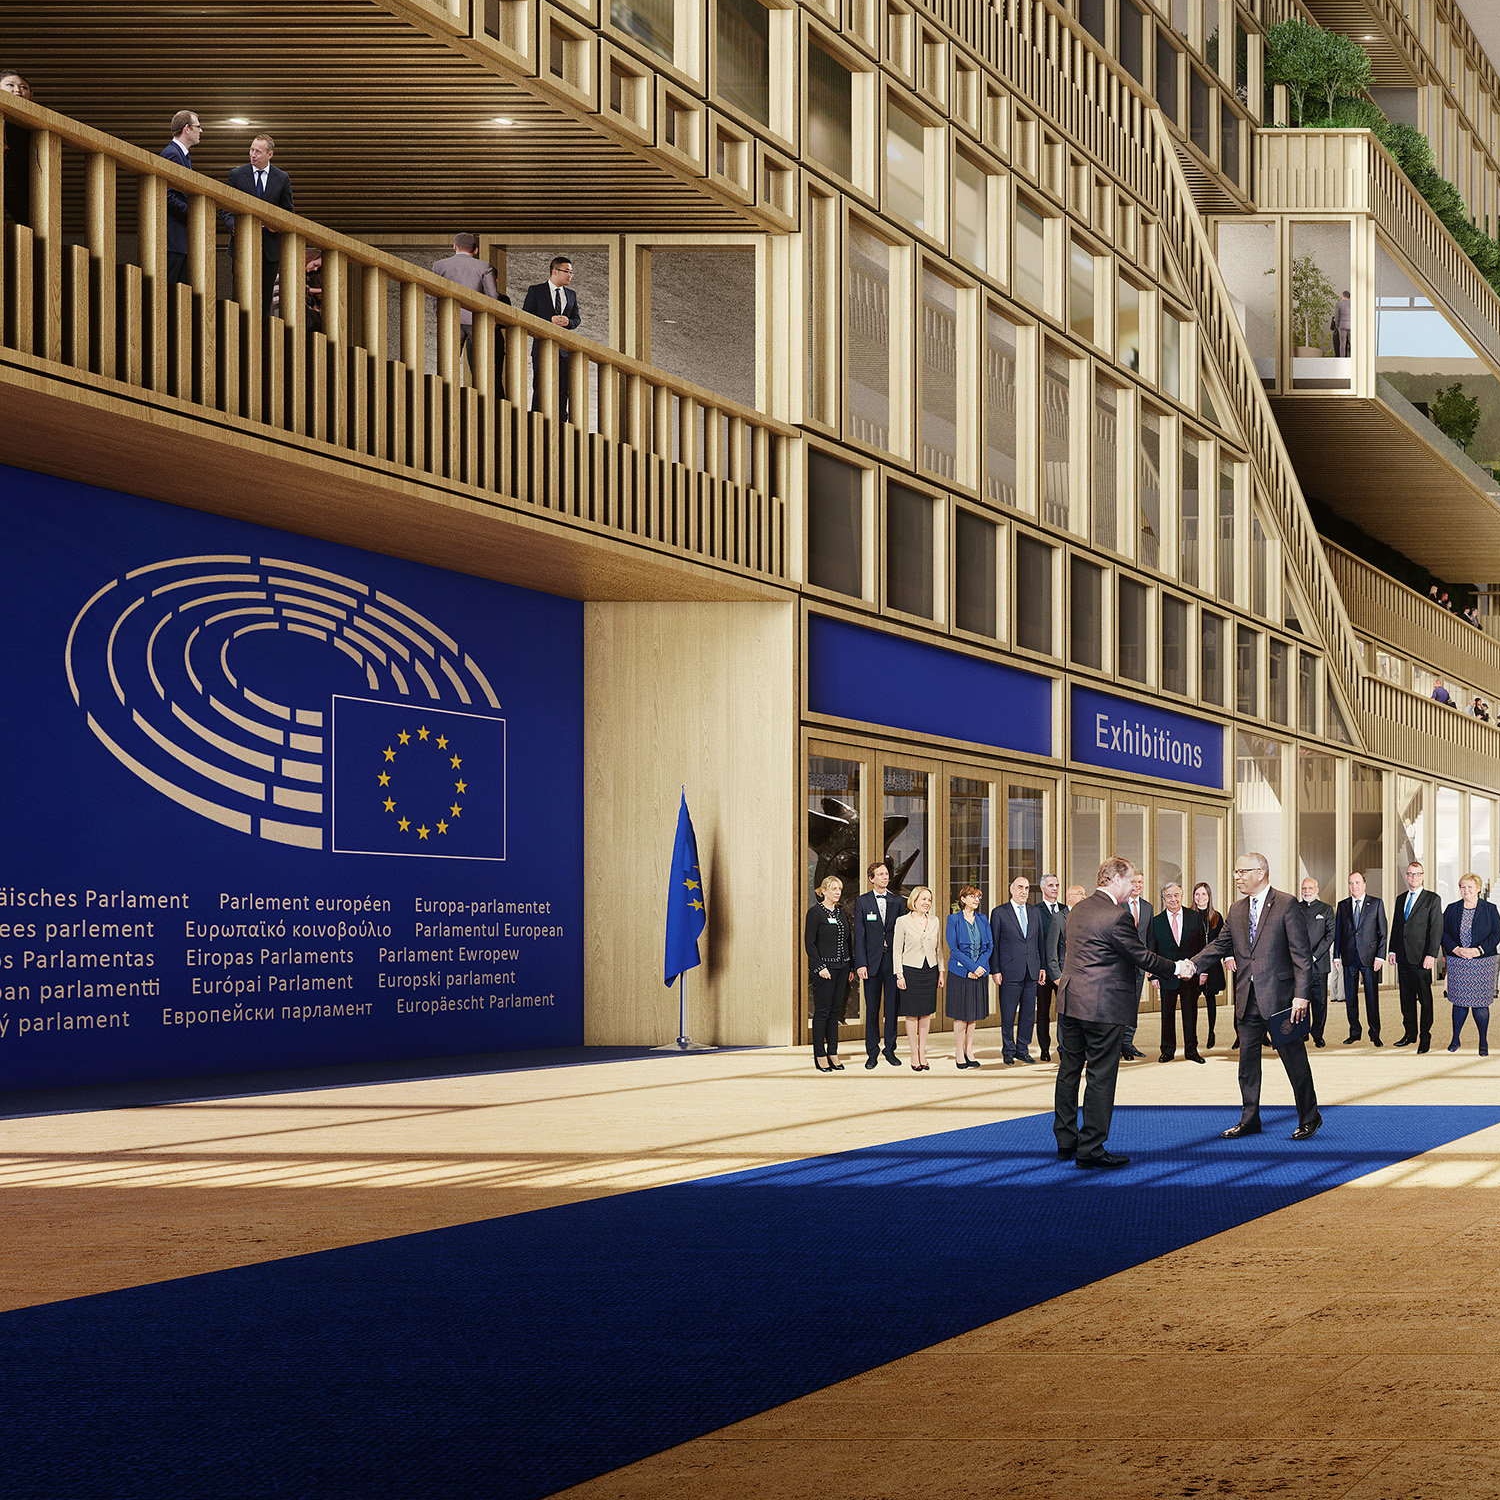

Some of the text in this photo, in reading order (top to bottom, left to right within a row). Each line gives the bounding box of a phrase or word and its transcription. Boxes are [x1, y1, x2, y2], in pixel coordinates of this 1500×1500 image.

[1096, 712, 1203, 769] Exhibitions
[86, 889, 190, 909] Parlament
[220, 892, 391, 916] Parlement européen
[415, 897, 551, 917] Europa-parlamentet
[0, 919, 155, 943] ees parlement
[186, 918, 392, 942] Ευρωπαϊκό κοινοβούλιο
[415, 921, 564, 941] Parlamentul European
[23, 949, 155, 969] Parlamentas
[186, 947, 354, 970] Eiropas Parlaments
[379, 946, 520, 964] Parlament Ewropew
[40, 977, 160, 1004] parlamentti
[192, 974, 353, 997] Európai Parlament
[378, 970, 516, 991] Europski parlament
[163, 1002, 373, 1029] Европейски парламент
[397, 993, 555, 1016] Europäescht Parlament
[19, 1011, 130, 1037] parlament
